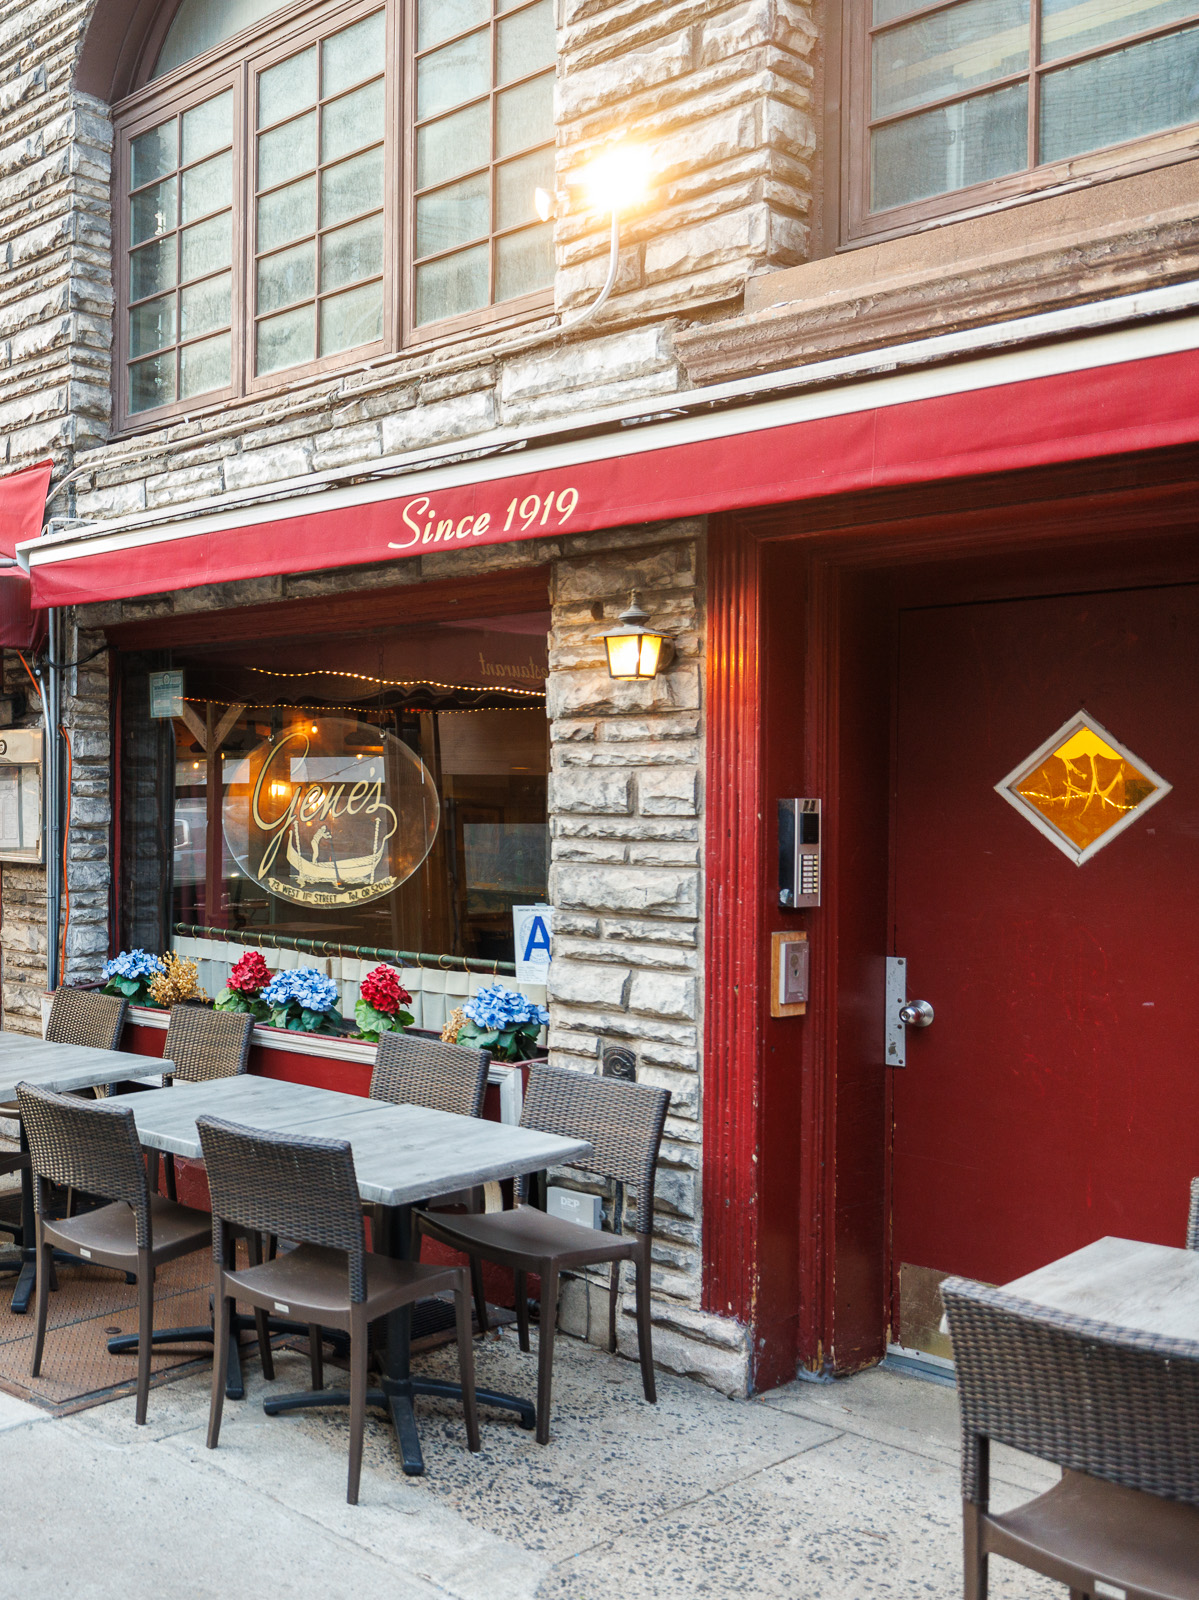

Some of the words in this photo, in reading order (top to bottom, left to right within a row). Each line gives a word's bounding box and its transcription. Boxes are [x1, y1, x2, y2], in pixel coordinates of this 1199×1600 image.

[387, 496, 491, 549] Since
[503, 487, 579, 532] 1919
[252, 733, 398, 879] Gene's
[282, 884, 299, 898] WEST
[314, 893, 337, 903] STREET
[523, 915, 553, 962] A
[560, 1195, 581, 1208] DEP
